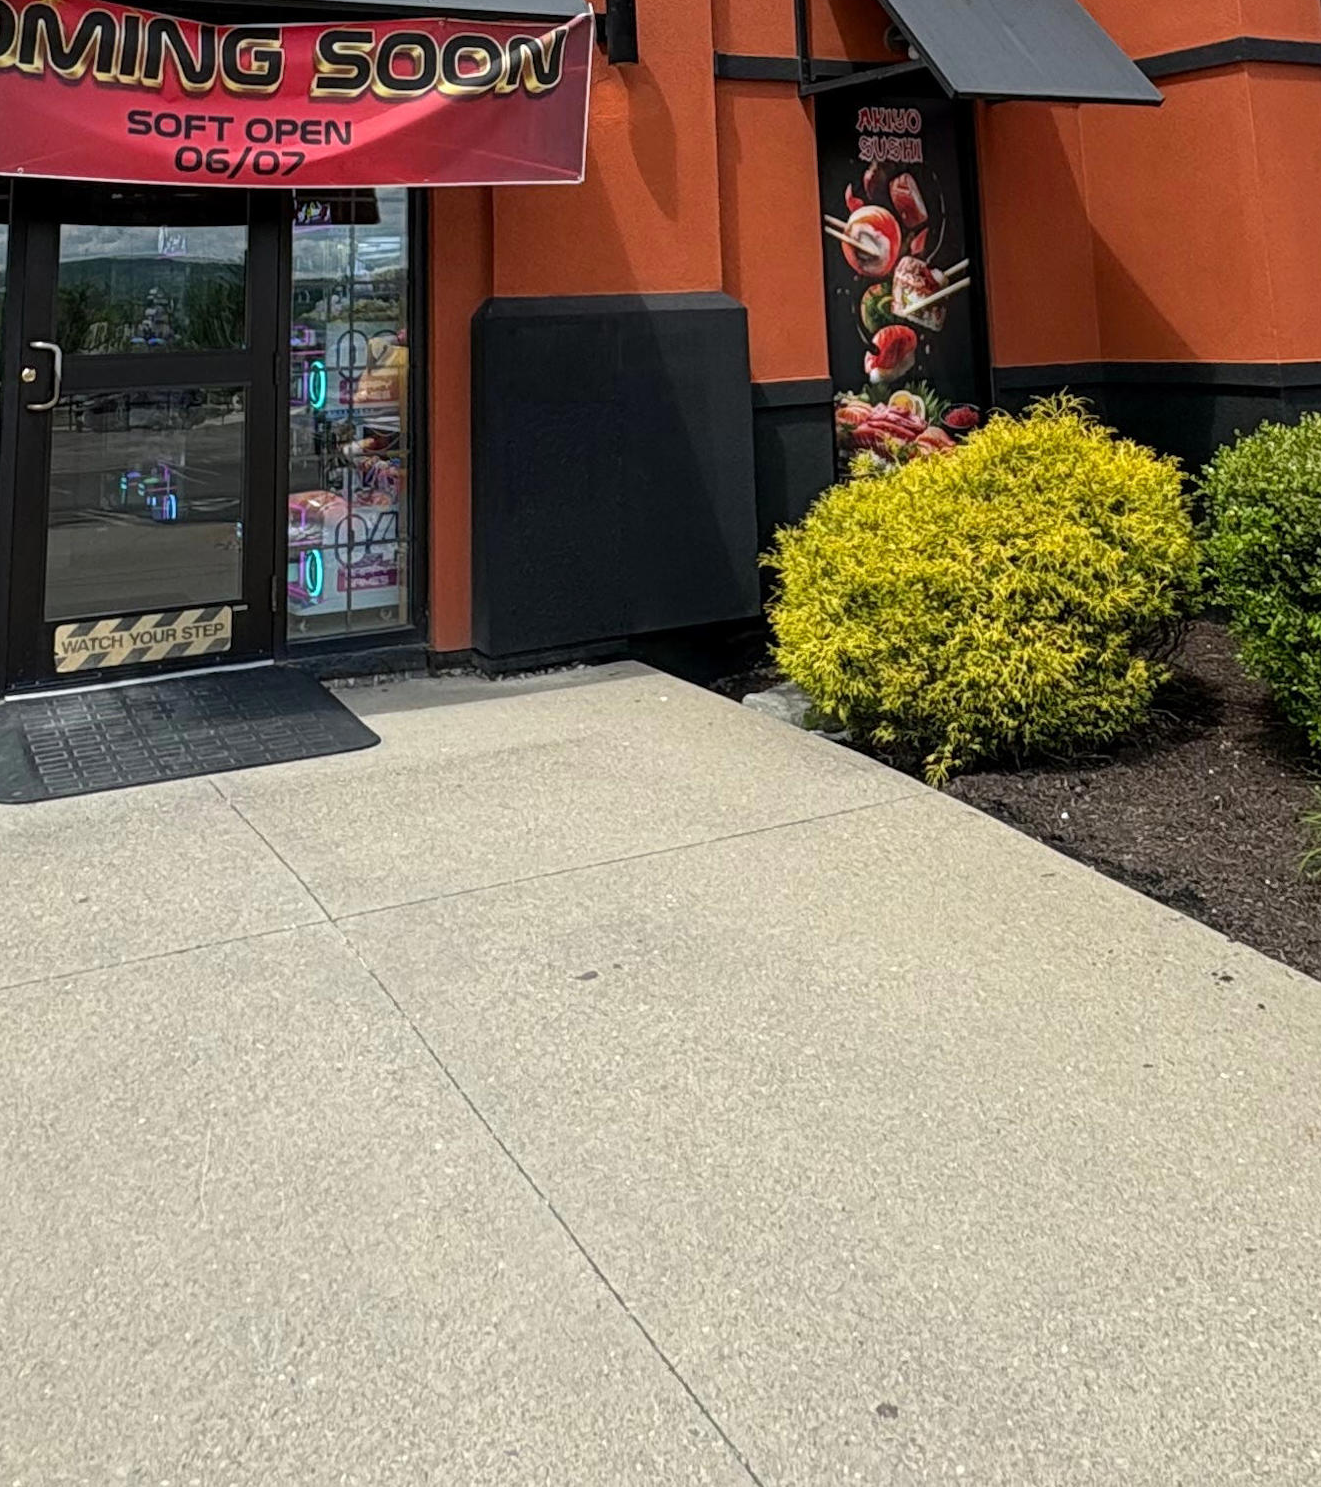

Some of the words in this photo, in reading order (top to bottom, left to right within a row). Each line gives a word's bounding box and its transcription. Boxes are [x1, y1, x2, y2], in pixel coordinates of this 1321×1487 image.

[310, 26, 569, 99] SOON
[127, 110, 235, 140] SOFT
[244, 117, 353, 146] OPEN
[855, 106, 922, 134] AKIYO
[174, 145, 307, 179] 06/07
[858, 135, 923, 163] SUSHI
[61, 635, 124, 655] WATCH
[129, 628, 178, 646] YOUR
[181, 622, 226, 641] STEP
